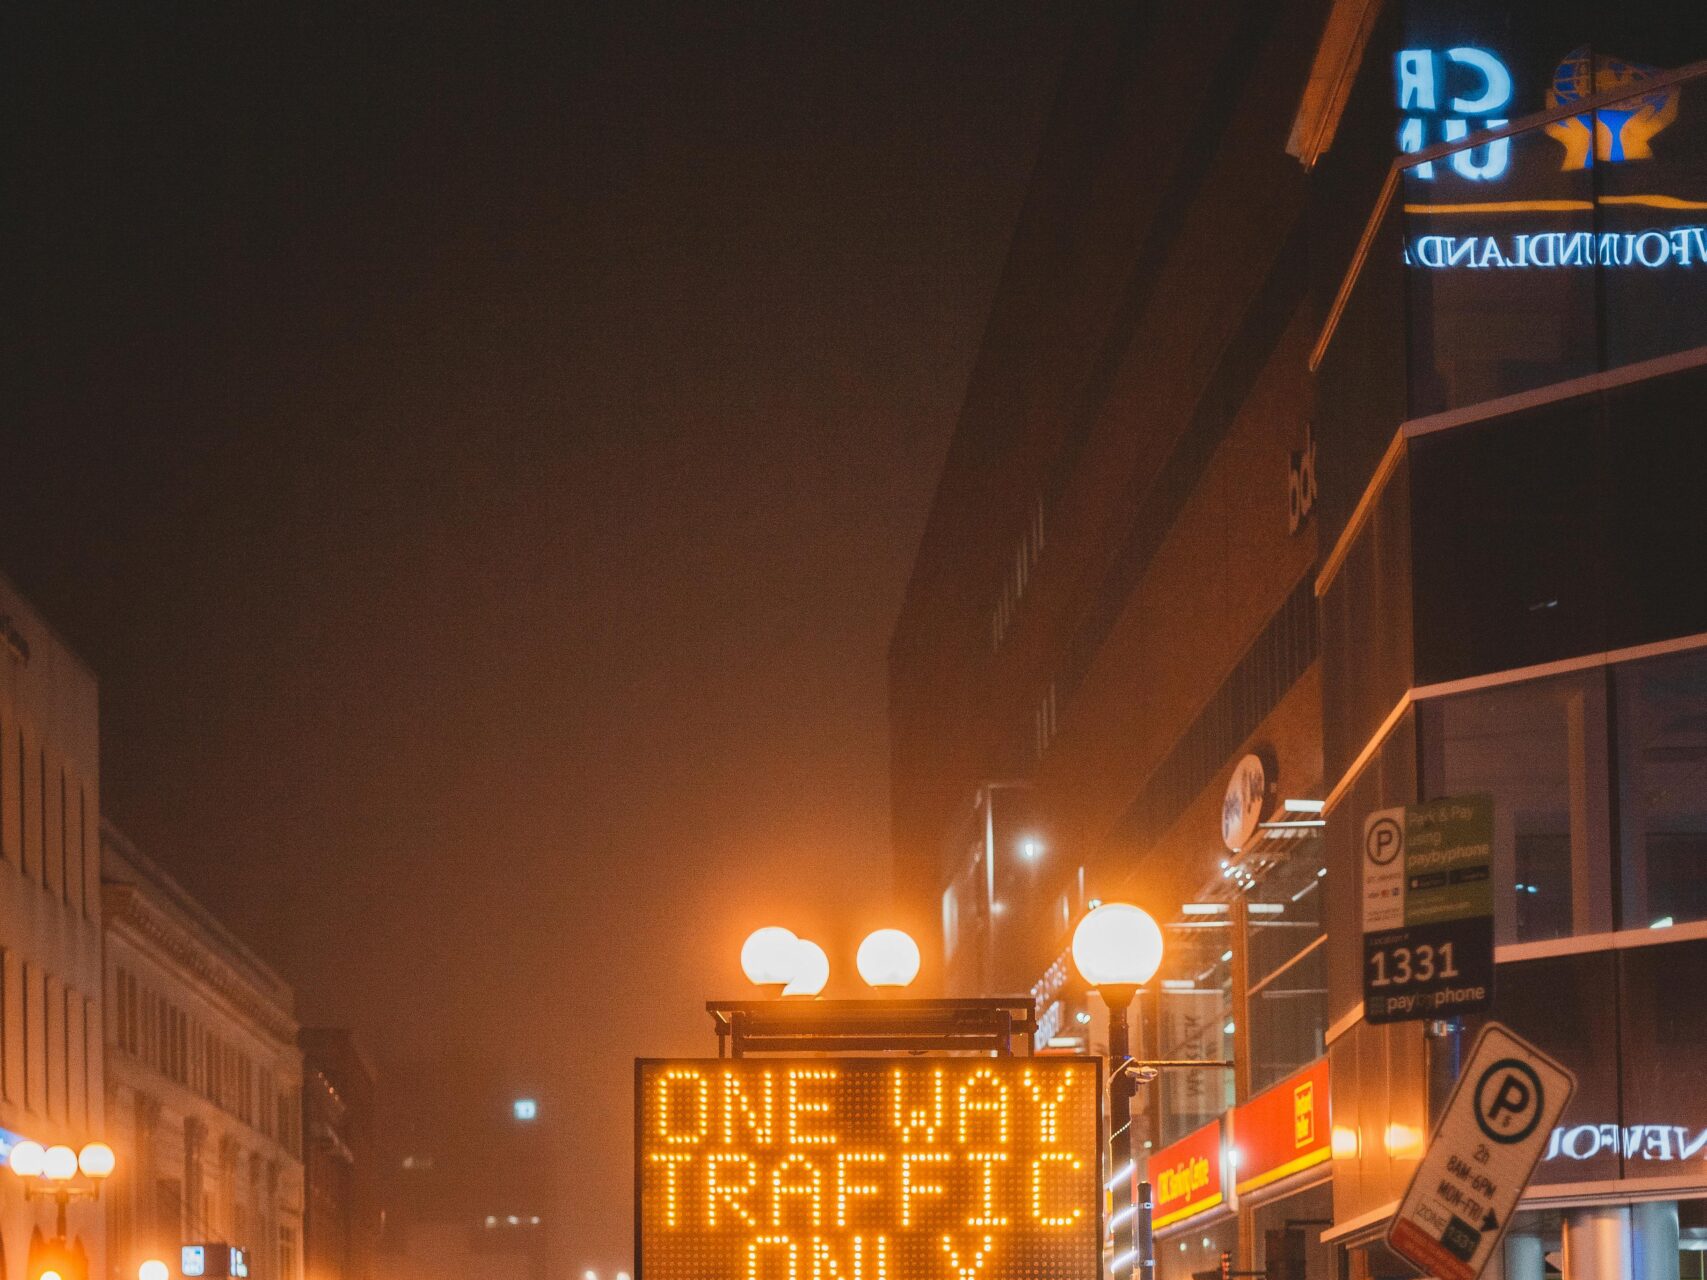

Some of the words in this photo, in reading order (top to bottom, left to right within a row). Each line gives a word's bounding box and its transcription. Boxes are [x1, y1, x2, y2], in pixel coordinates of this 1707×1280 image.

[1371, 942, 1458, 986] 1331
[660, 1071, 837, 1144] ONE
[894, 1071, 1073, 1144] WAY
[1488, 1074, 1530, 1121] P
[652, 1153, 1082, 1226] TRAFFIC
